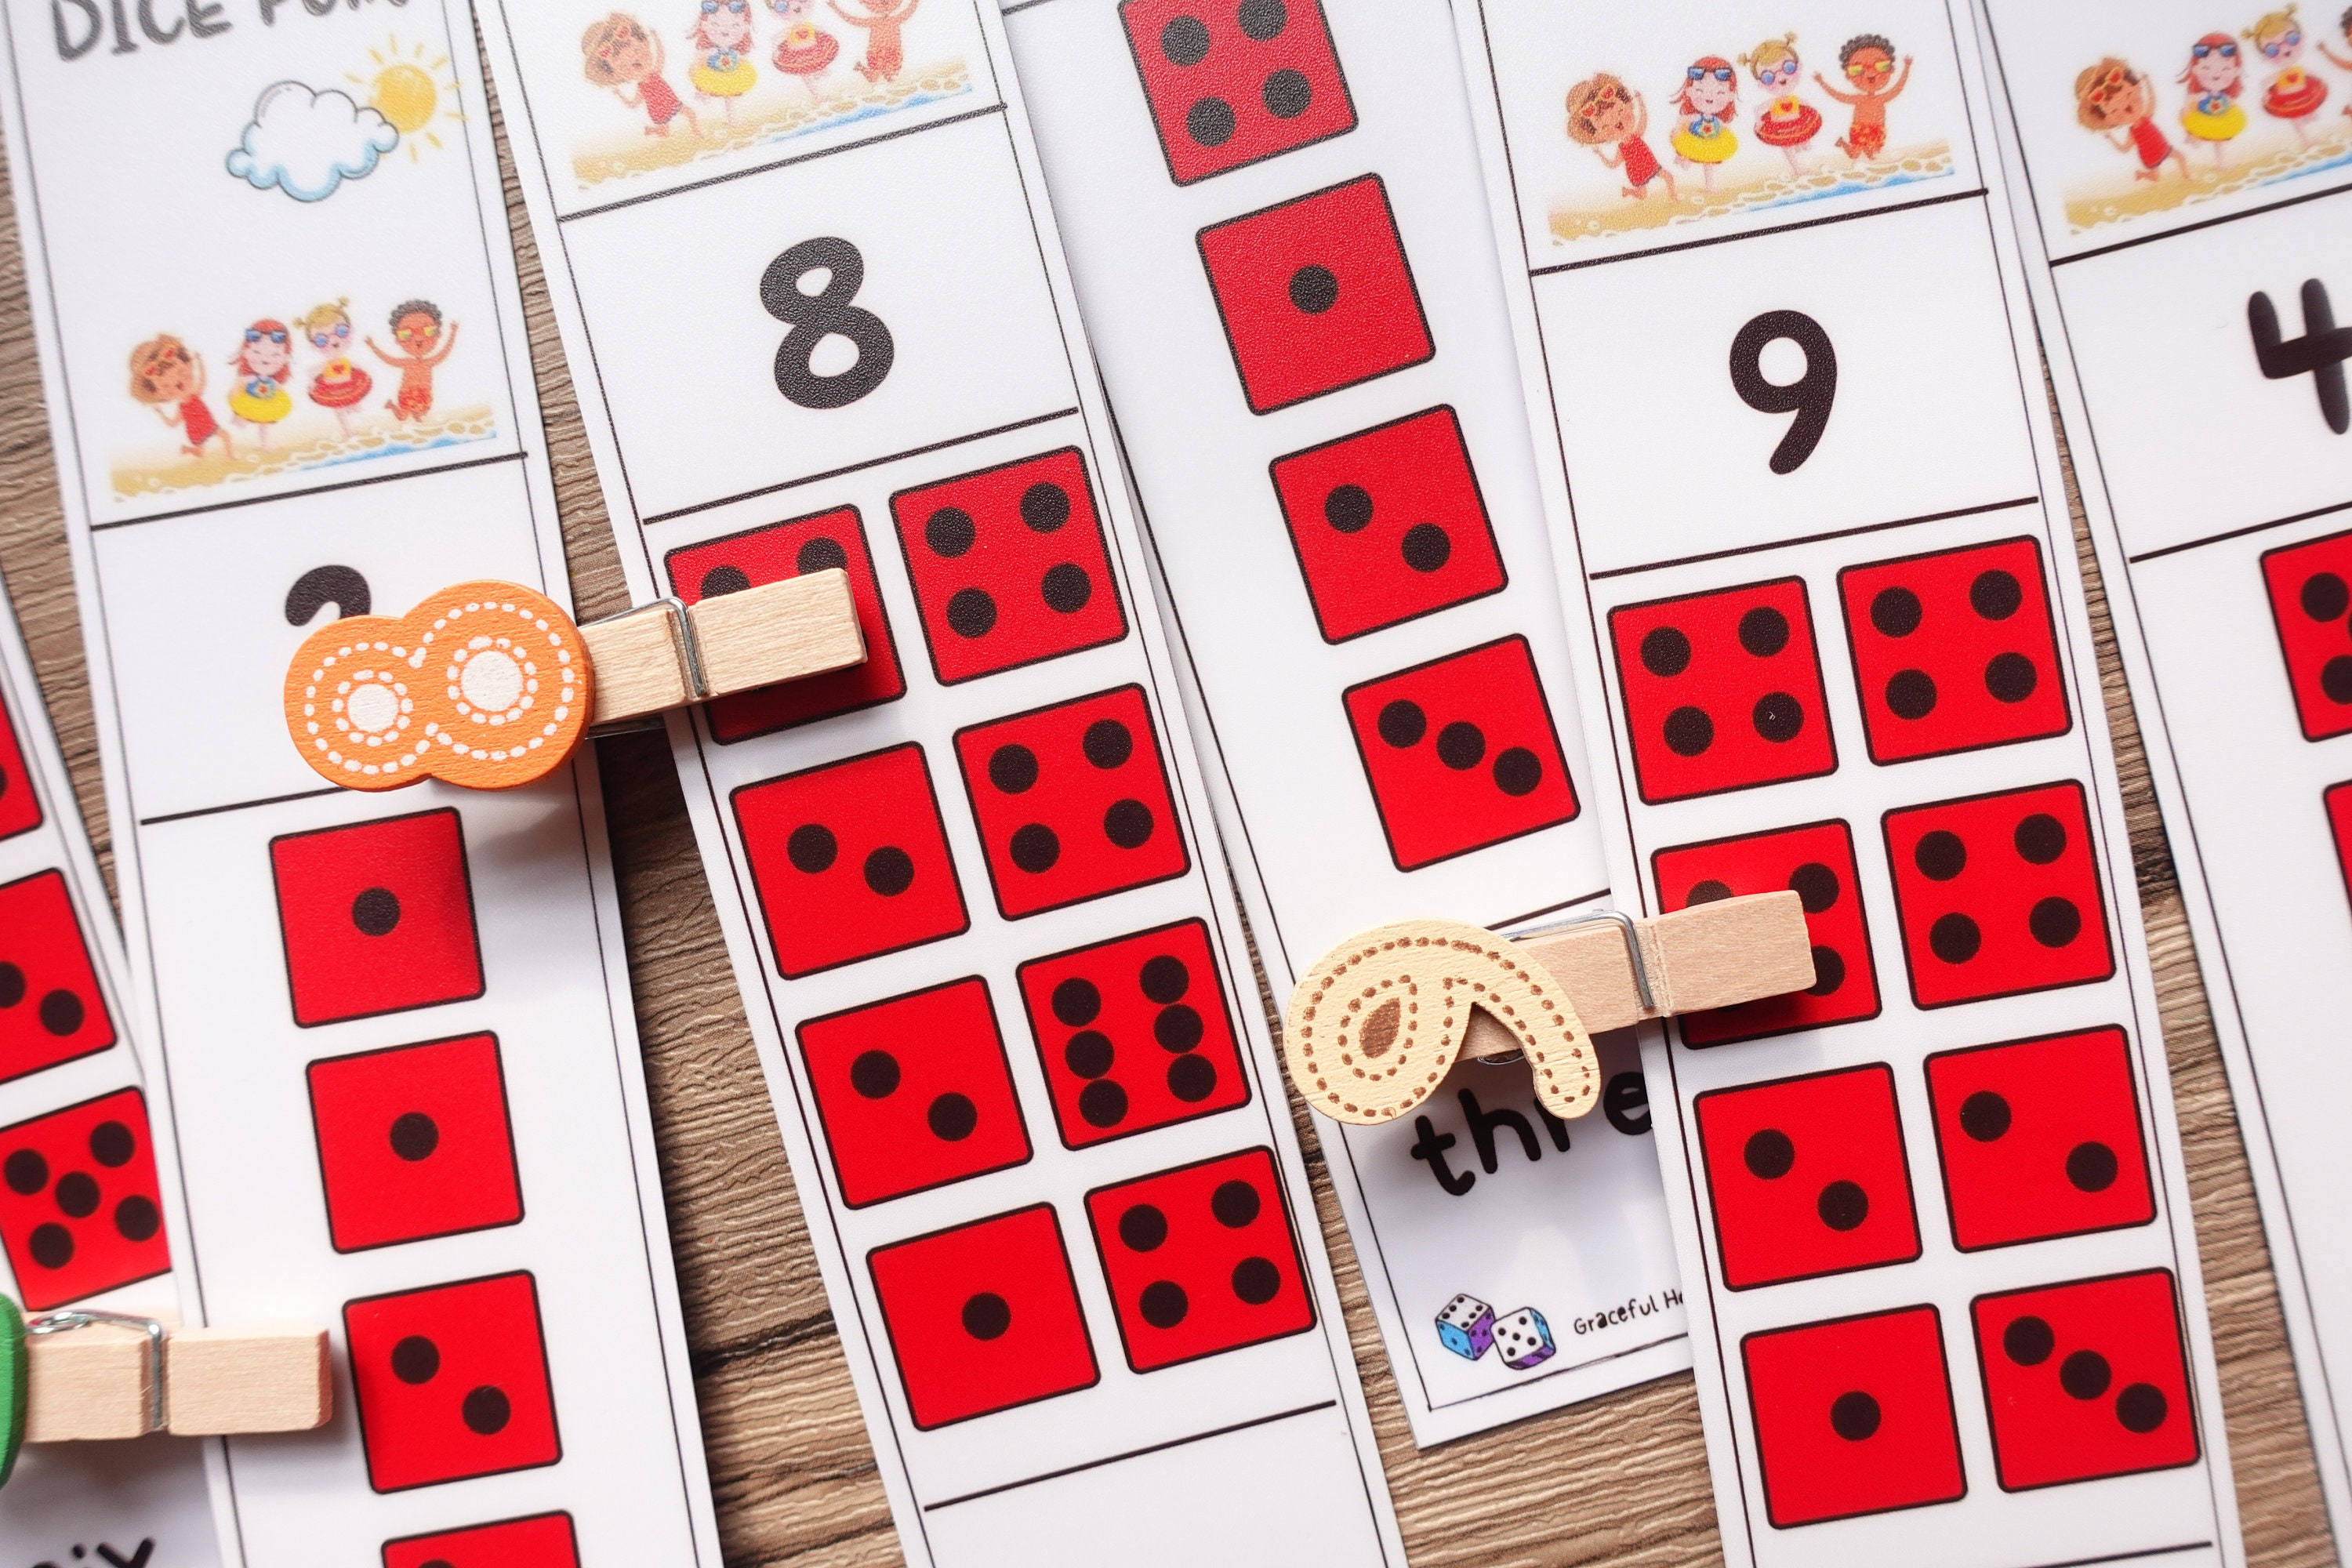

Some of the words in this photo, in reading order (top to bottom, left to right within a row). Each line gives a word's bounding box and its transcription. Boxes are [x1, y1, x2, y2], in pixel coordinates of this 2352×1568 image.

[759, 235, 895, 410] 8
[1729, 309, 1838, 475] 9
[2247, 278, 2352, 434] 4
[1573, 1294, 1659, 1334] Graceful
